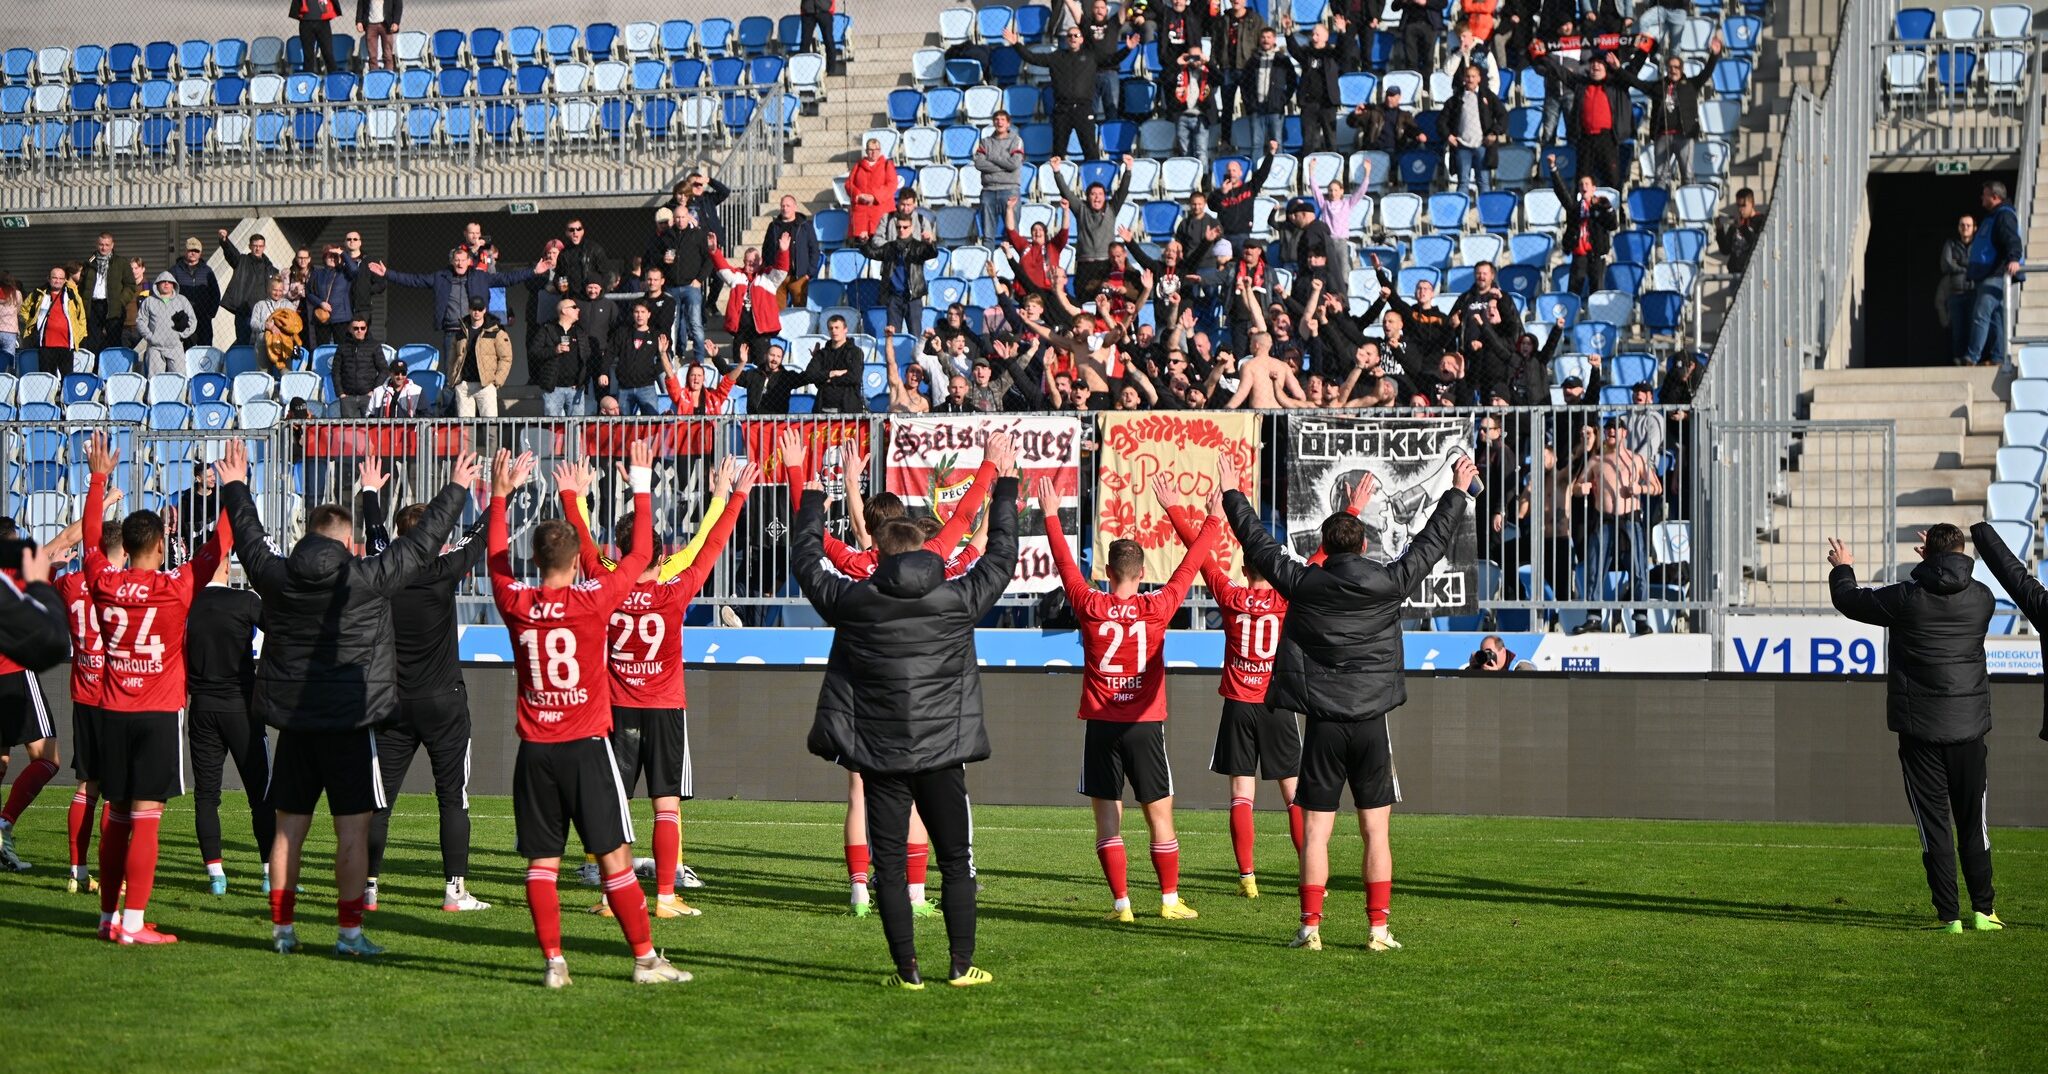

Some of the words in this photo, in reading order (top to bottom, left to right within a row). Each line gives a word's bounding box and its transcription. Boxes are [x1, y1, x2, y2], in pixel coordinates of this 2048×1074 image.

[893, 418, 1076, 463] Szélsőéges
[1132, 453, 1213, 496] Pécs
[103, 606, 165, 662] 24
[609, 612, 666, 660] 29
[1098, 621, 1147, 673] 21
[1235, 613, 1279, 659] 10
[519, 628, 580, 690] 18
[1568, 658, 1592, 667] MTK
[1732, 638, 1791, 673] V1
[1810, 638, 1876, 674] B9
[1986, 651, 2041, 659] HIDEGKUT
[1105, 676, 1142, 689] TERBE
[1113, 692, 1135, 701] PMFC
[1243, 675, 1263, 685] PMFC
[538, 710, 564, 722] PMFC
